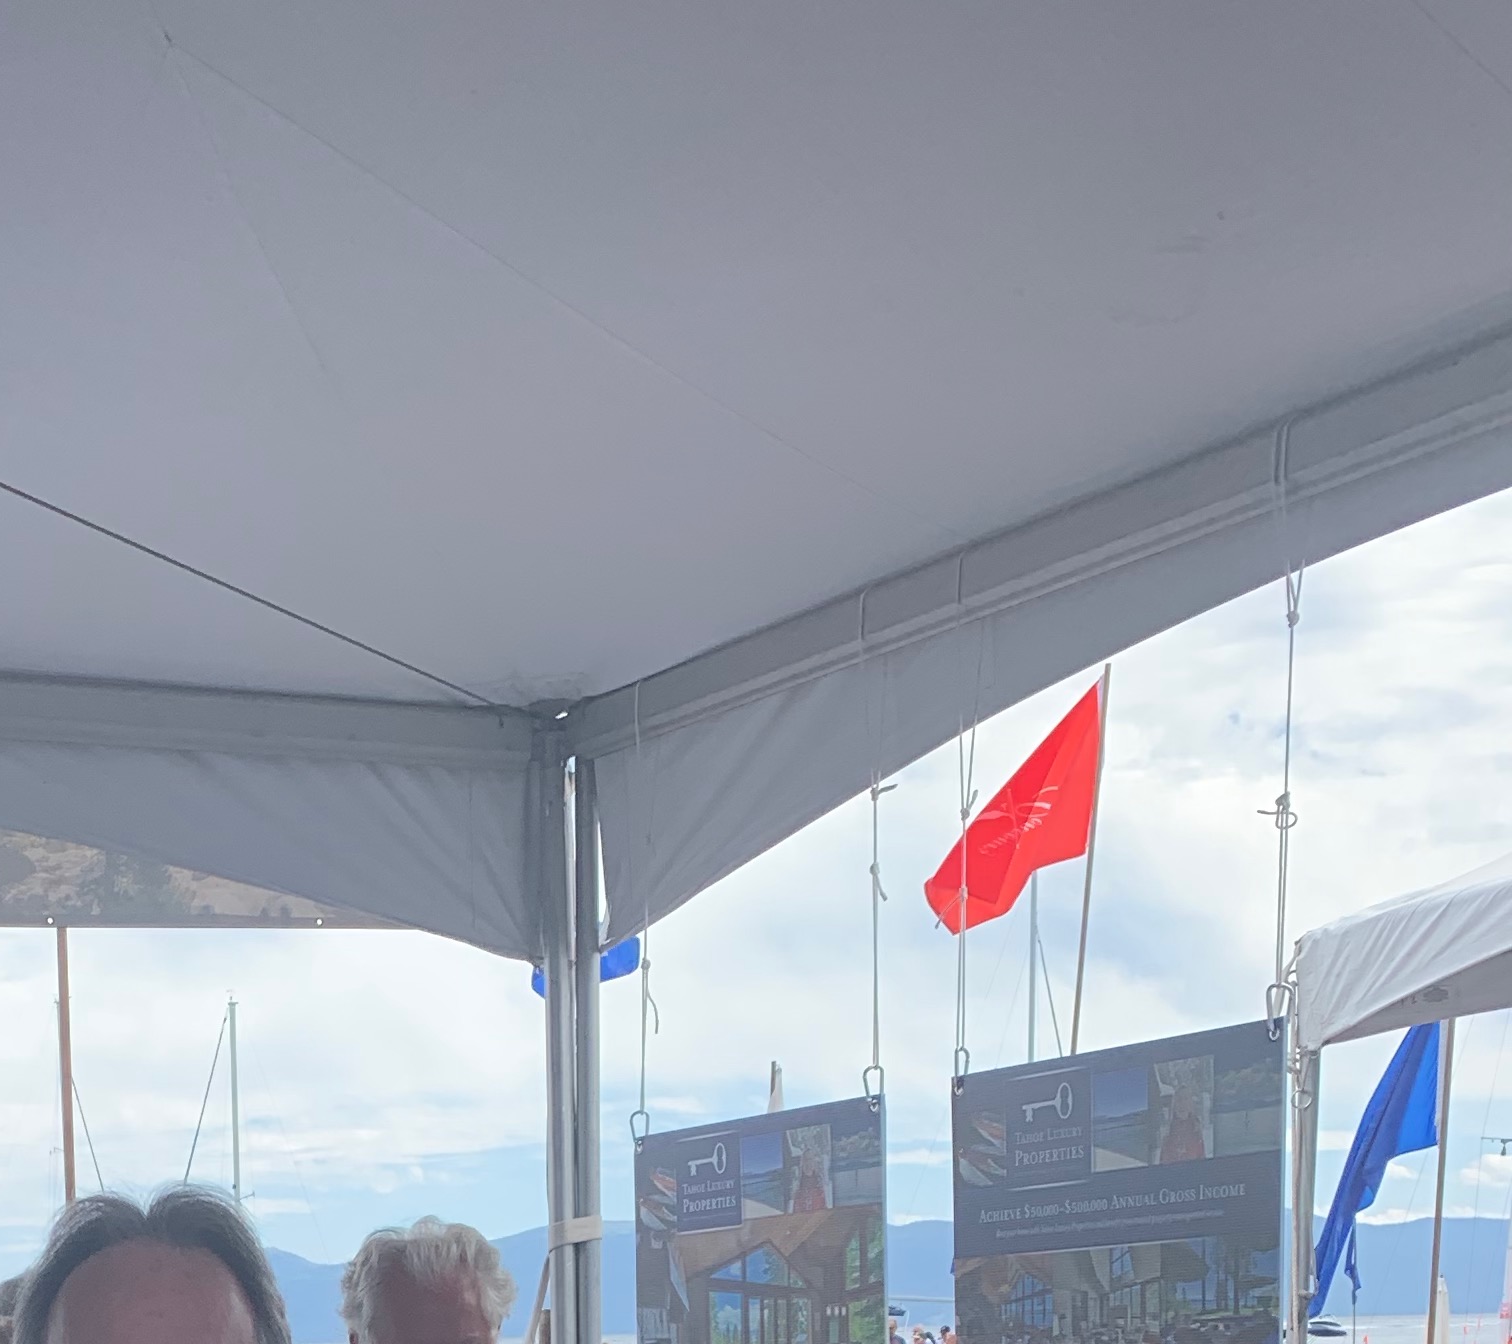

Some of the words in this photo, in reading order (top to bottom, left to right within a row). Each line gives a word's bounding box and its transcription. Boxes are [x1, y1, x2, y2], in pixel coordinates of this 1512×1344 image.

[1015, 1145, 1084, 1166] PROPERTIES
[683, 1196, 736, 1213] PROPERTIES
[979, 1208, 1022, 1223] ACHIEVE
[1110, 1194, 1157, 1209] ANNUAL
[1159, 1188, 1196, 1204] GROSS
[1199, 1184, 1246, 1200] INCOME
